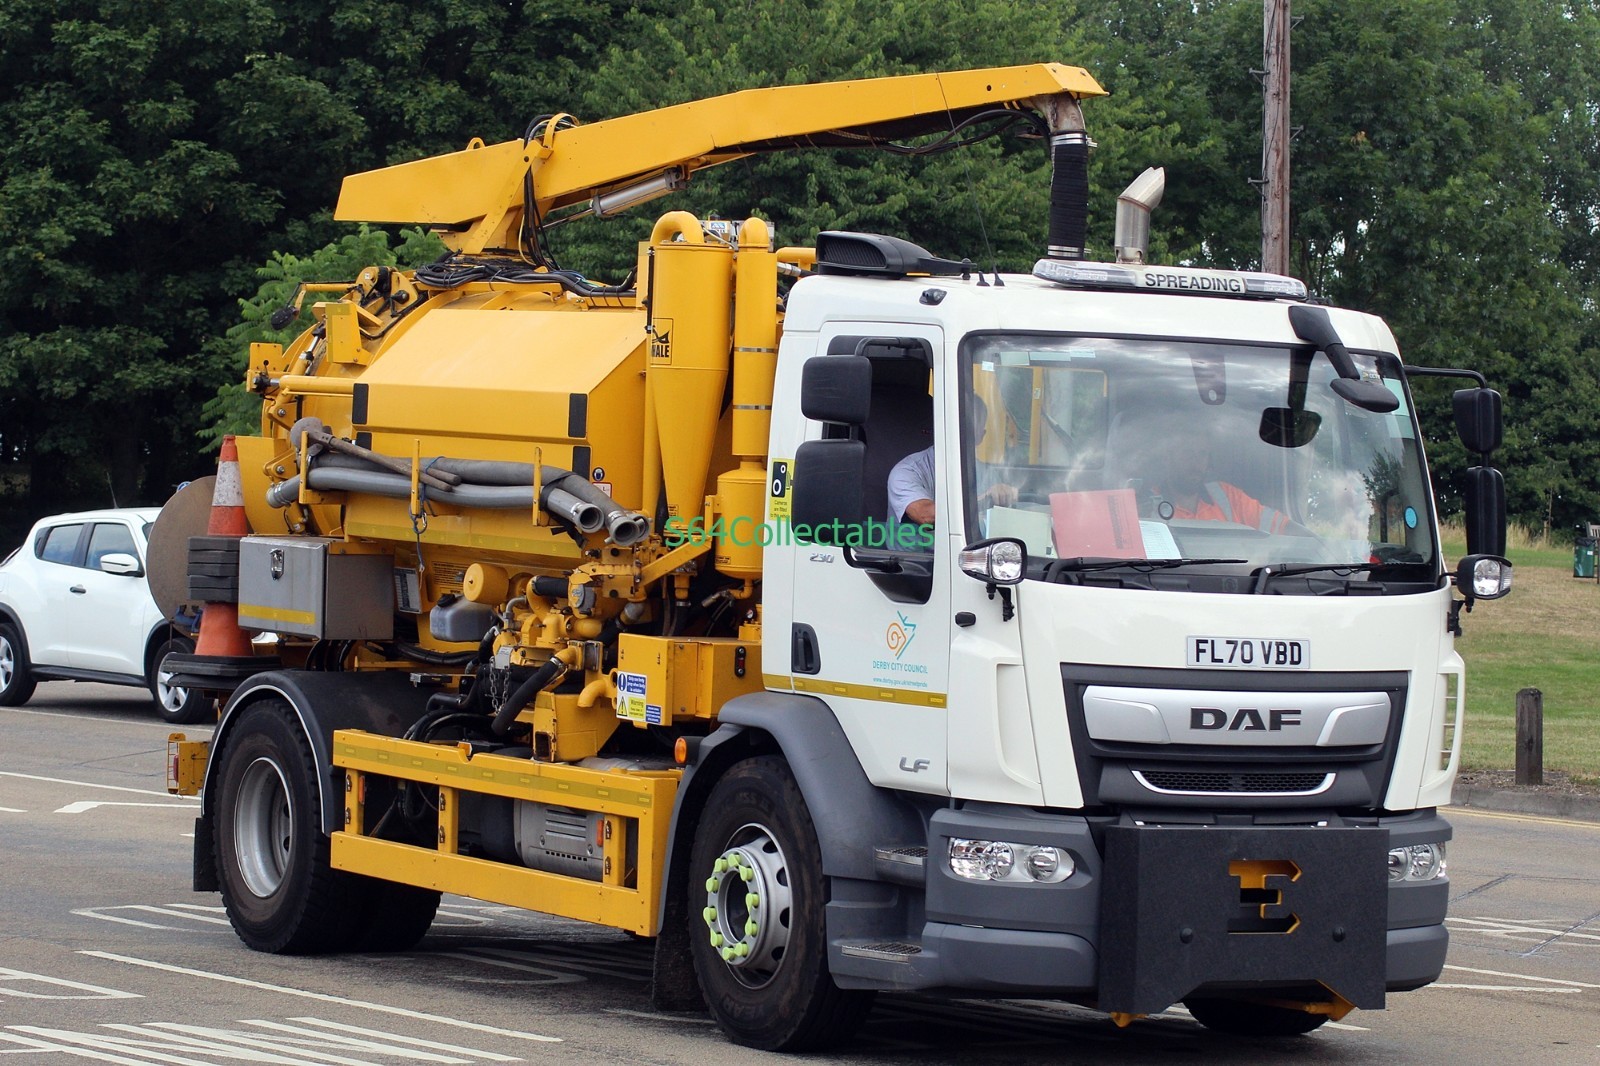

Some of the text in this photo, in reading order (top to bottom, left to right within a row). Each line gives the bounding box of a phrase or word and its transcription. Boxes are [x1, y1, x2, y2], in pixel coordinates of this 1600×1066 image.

[1145, 273, 1241, 293] SPREADING
[809, 552, 834, 563] 230
[1195, 639, 1302, 665] FL70 VBD
[872, 660, 928, 674] DERBY CITY COUNCIL
[1190, 707, 1301, 731] DAF
[899, 756, 930, 773] LF
